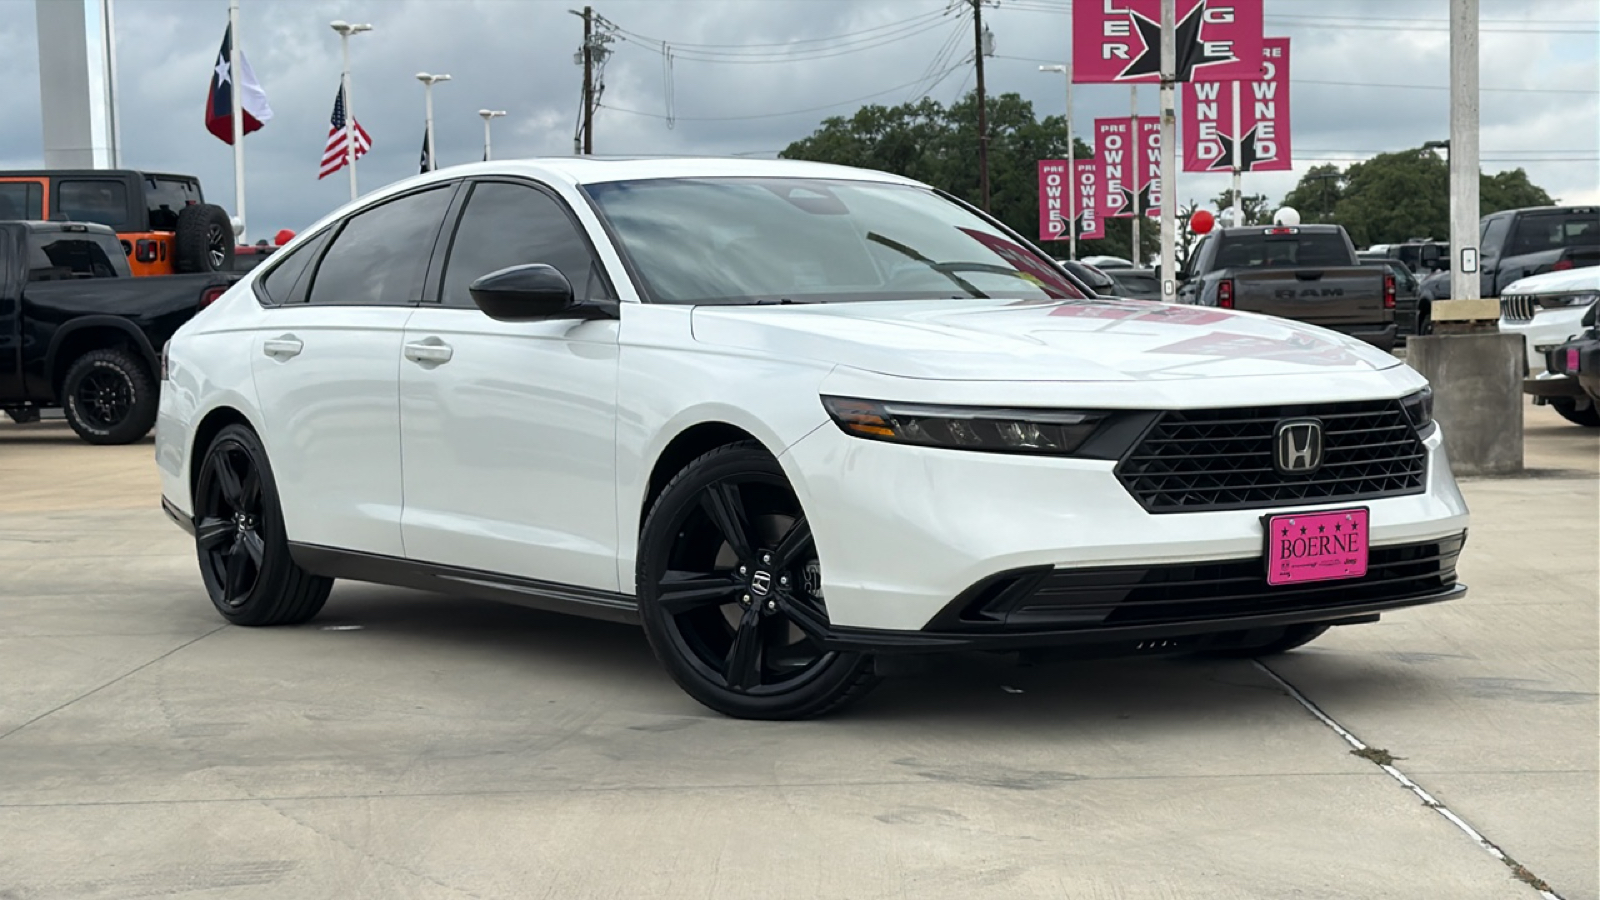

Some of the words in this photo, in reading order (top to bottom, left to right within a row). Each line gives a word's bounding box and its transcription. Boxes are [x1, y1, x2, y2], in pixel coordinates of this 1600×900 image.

[1262, 46, 1282, 58] RE
[1101, 124, 1126, 133] PRE
[1144, 123, 1160, 132] PR
[1195, 82, 1220, 159] WNED
[1043, 165, 1064, 173] PRE
[1104, 135, 1123, 208] OWNED
[1046, 174, 1061, 233] OWNED
[1080, 173, 1096, 231] OWNED
[1275, 288, 1344, 299] RAM
[1280, 532, 1359, 560] BOERNE
